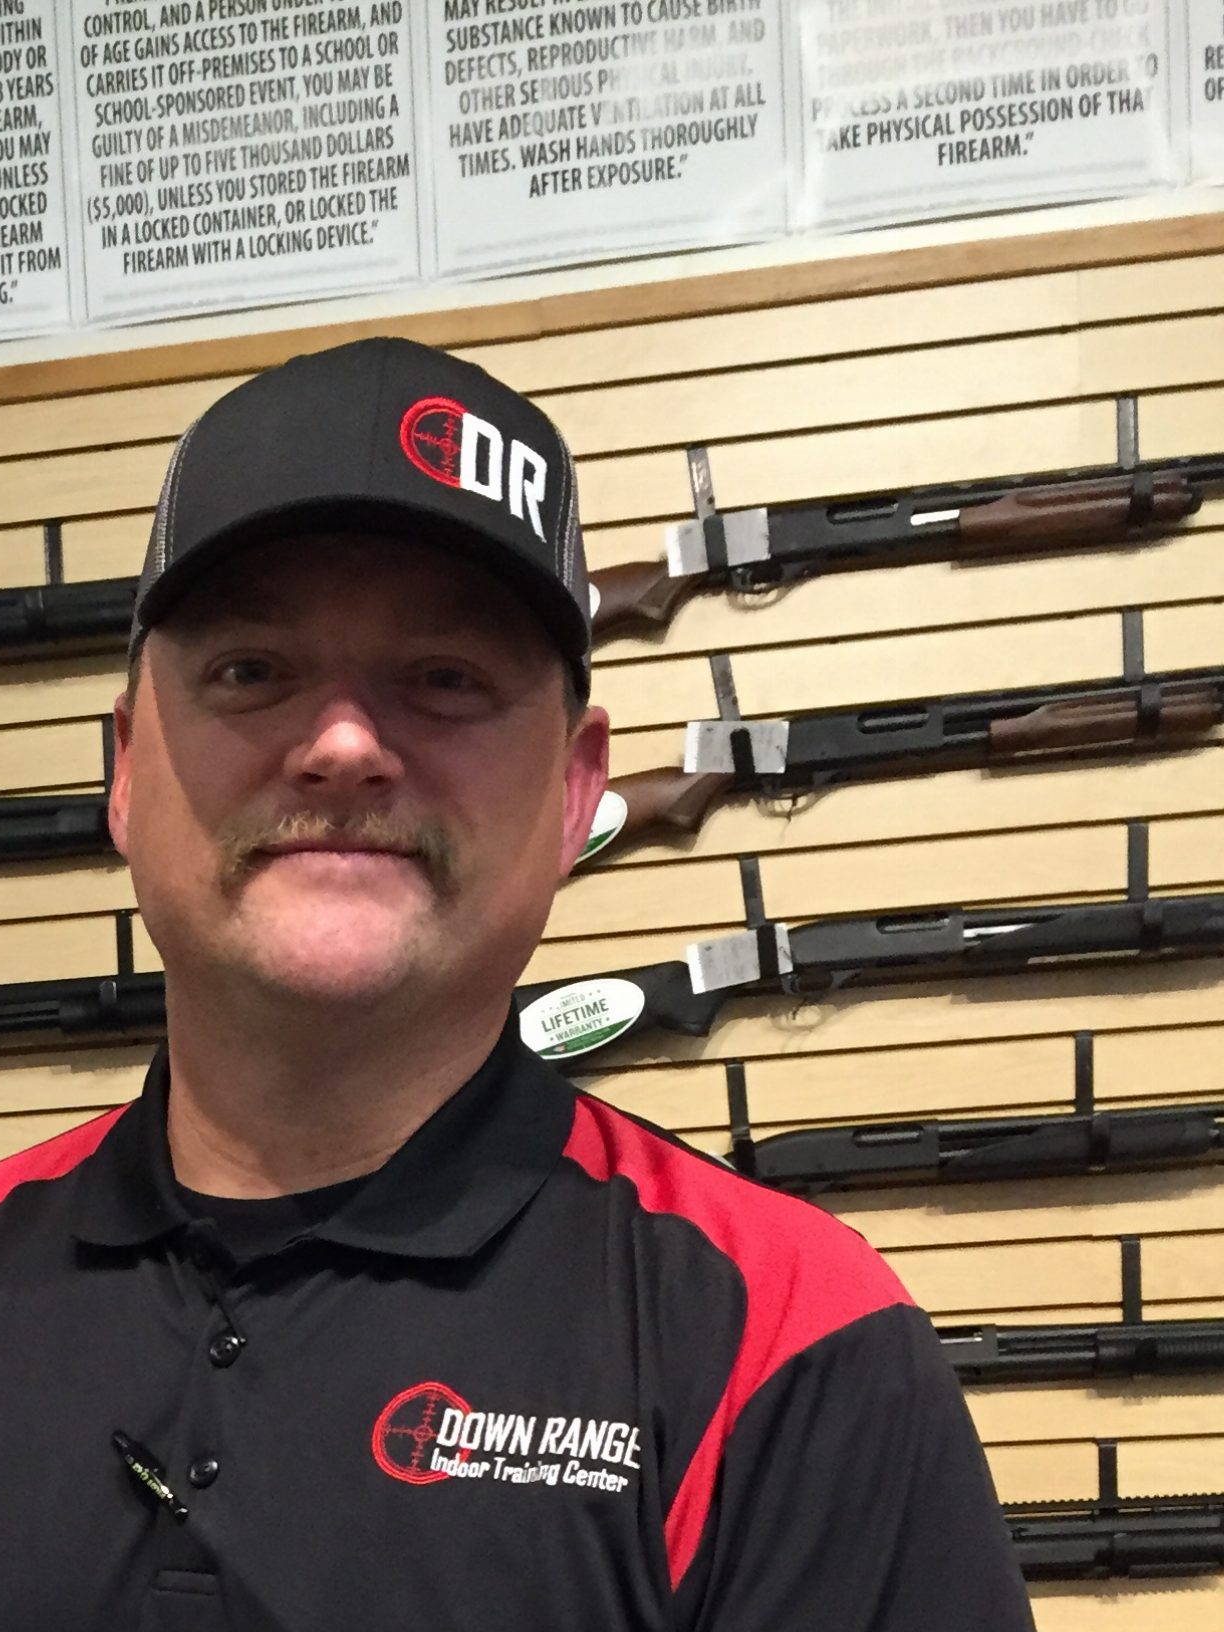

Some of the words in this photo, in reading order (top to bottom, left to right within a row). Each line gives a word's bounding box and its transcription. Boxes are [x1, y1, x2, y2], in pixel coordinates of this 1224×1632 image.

[446, 15, 544, 52] SUBSTANCE
[549, 6, 616, 36] KNOWN
[620, 0, 643, 26] TO
[25, 45, 47, 70] OR
[95, 84, 245, 126] SCHOOL-SPONSORED
[249, 76, 300, 105] EVENT,
[302, 71, 333, 97] YOU
[337, 66, 370, 93] MAY
[374, 63, 393, 89] BE
[865, 112, 956, 146] PHYSICAL
[957, 97, 1074, 132] POSSESSION
[1076, 91, 1102, 120] OF
[19, 130, 51, 158] MAY
[100, 161, 133, 188] FINE
[136, 158, 155, 184] OF
[159, 155, 179, 180] UP
[182, 152, 201, 177] TO
[205, 147, 237, 174] FIVE
[240, 136, 323, 168] THOUSAND
[326, 125, 394, 157] DOLLARS
[520, 139, 571, 168] WASH
[576, 130, 636, 159] HANDS
[640, 115, 758, 150] THOROUGHLY
[529, 168, 582, 198] AFTER
[123, 245, 189, 274] FIREARM
[192, 239, 231, 265] WITH
[235, 237, 246, 260] A
[249, 229, 313, 258] LOCKING
[460, 412, 547, 543] DR
[541, 998, 609, 1032] LIFETIME
[555, 1017, 603, 1042] WARRANTY
[436, 1407, 536, 1455] DOWN
[539, 1416, 642, 1470] RANGE
[430, 1448, 490, 1479] Indoor
[492, 1456, 559, 1486] Training
[562, 1460, 629, 1493] Center
